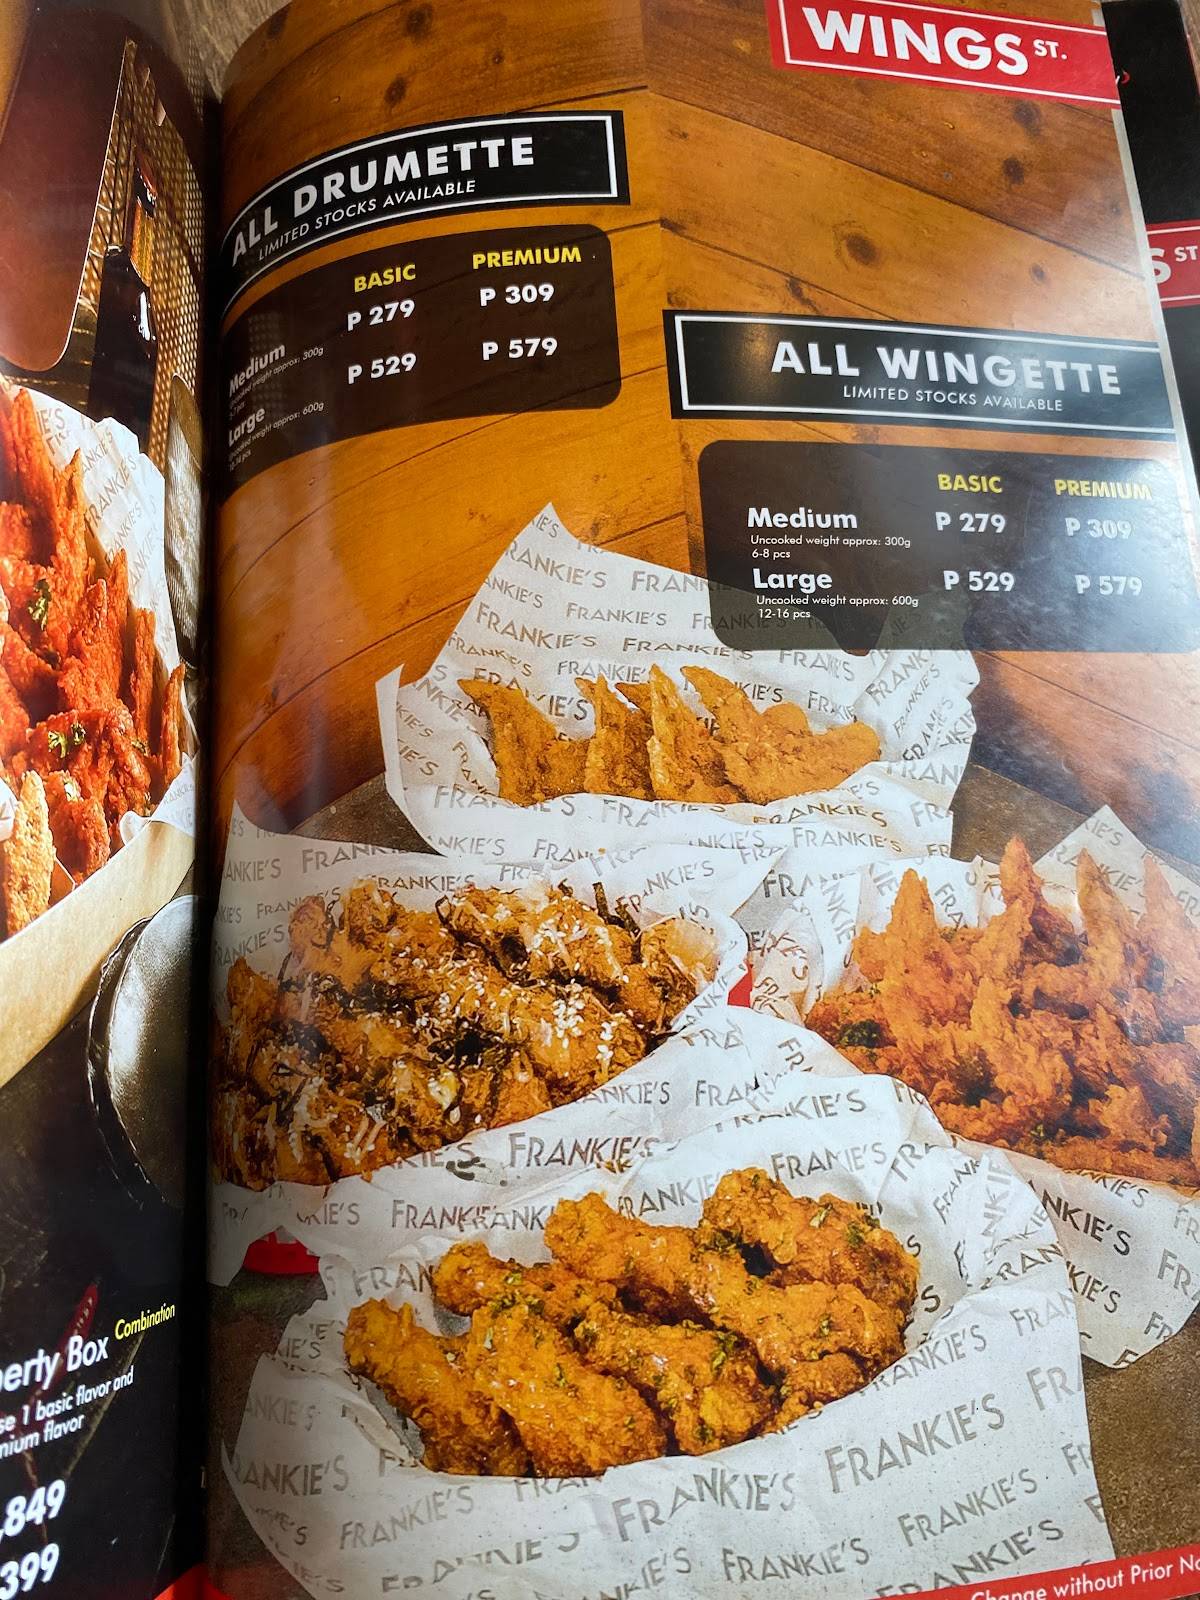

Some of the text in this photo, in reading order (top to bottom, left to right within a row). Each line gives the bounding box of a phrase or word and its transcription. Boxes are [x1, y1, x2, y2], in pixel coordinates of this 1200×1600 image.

[802, 7, 1068, 76] WINGS ST.
[231, 136, 535, 267] ALL DRUMETTE
[258, 179, 477, 261] LIMITED STOCKS AVAILABLE
[353, 246, 582, 293] BASIC PREMIUM
[347, 284, 555, 331] P 279 P 309
[230, 344, 286, 398] Medium
[303, 346, 324, 361] 300g
[348, 337, 558, 385] P 529 P 579
[771, 340, 1122, 397] ALL WINGETTE
[303, 402, 324, 416] 600g
[843, 385, 1063, 413] LIMITED STOCKS AVAILABLE
[229, 408, 265, 448] Large
[937, 473, 1152, 501] BASIC PREMIUM
[747, 507, 858, 531] Medium
[936, 511, 1133, 540] P 279 P 309
[750, 534, 912, 550] Uncooked weight approx: 300g
[752, 548, 791, 562] 6-8 pcs
[752, 567, 833, 593] Large
[943, 571, 1143, 597] P 529 P 579
[566, 602, 668, 626] FRANKIE'S
[756, 594, 919, 609] Uncooked weight approx: 600g
[758, 608, 811, 622] 12-16 pcs
[476, 600, 597, 650] FRANKIE'S
[557, 659, 651, 684] FRANKIE'
[793, 827, 903, 852] FRANKIE'S
[115, 1303, 175, 1341] Combination
[67, 1335, 110, 1373] Box
[22, 1404, 30, 1426] 1
[36, 1391, 74, 1422] basic
[76, 1380, 111, 1406] flavor
[113, 1364, 134, 1393] and
[44, 1414, 84, 1442] flavor
[825, 1393, 1005, 1494] FRANKIE'S
[339, 1485, 475, 1550] FRANKIE'S
[611, 1467, 797, 1542] FRANKIE'S
[897, 1468, 1038, 1547] FRANKIE'S
[722, 1537, 871, 1583] FRANKIE'S
[1054, 1570, 1125, 1598] without
[1131, 1562, 1173, 1585] Prior
